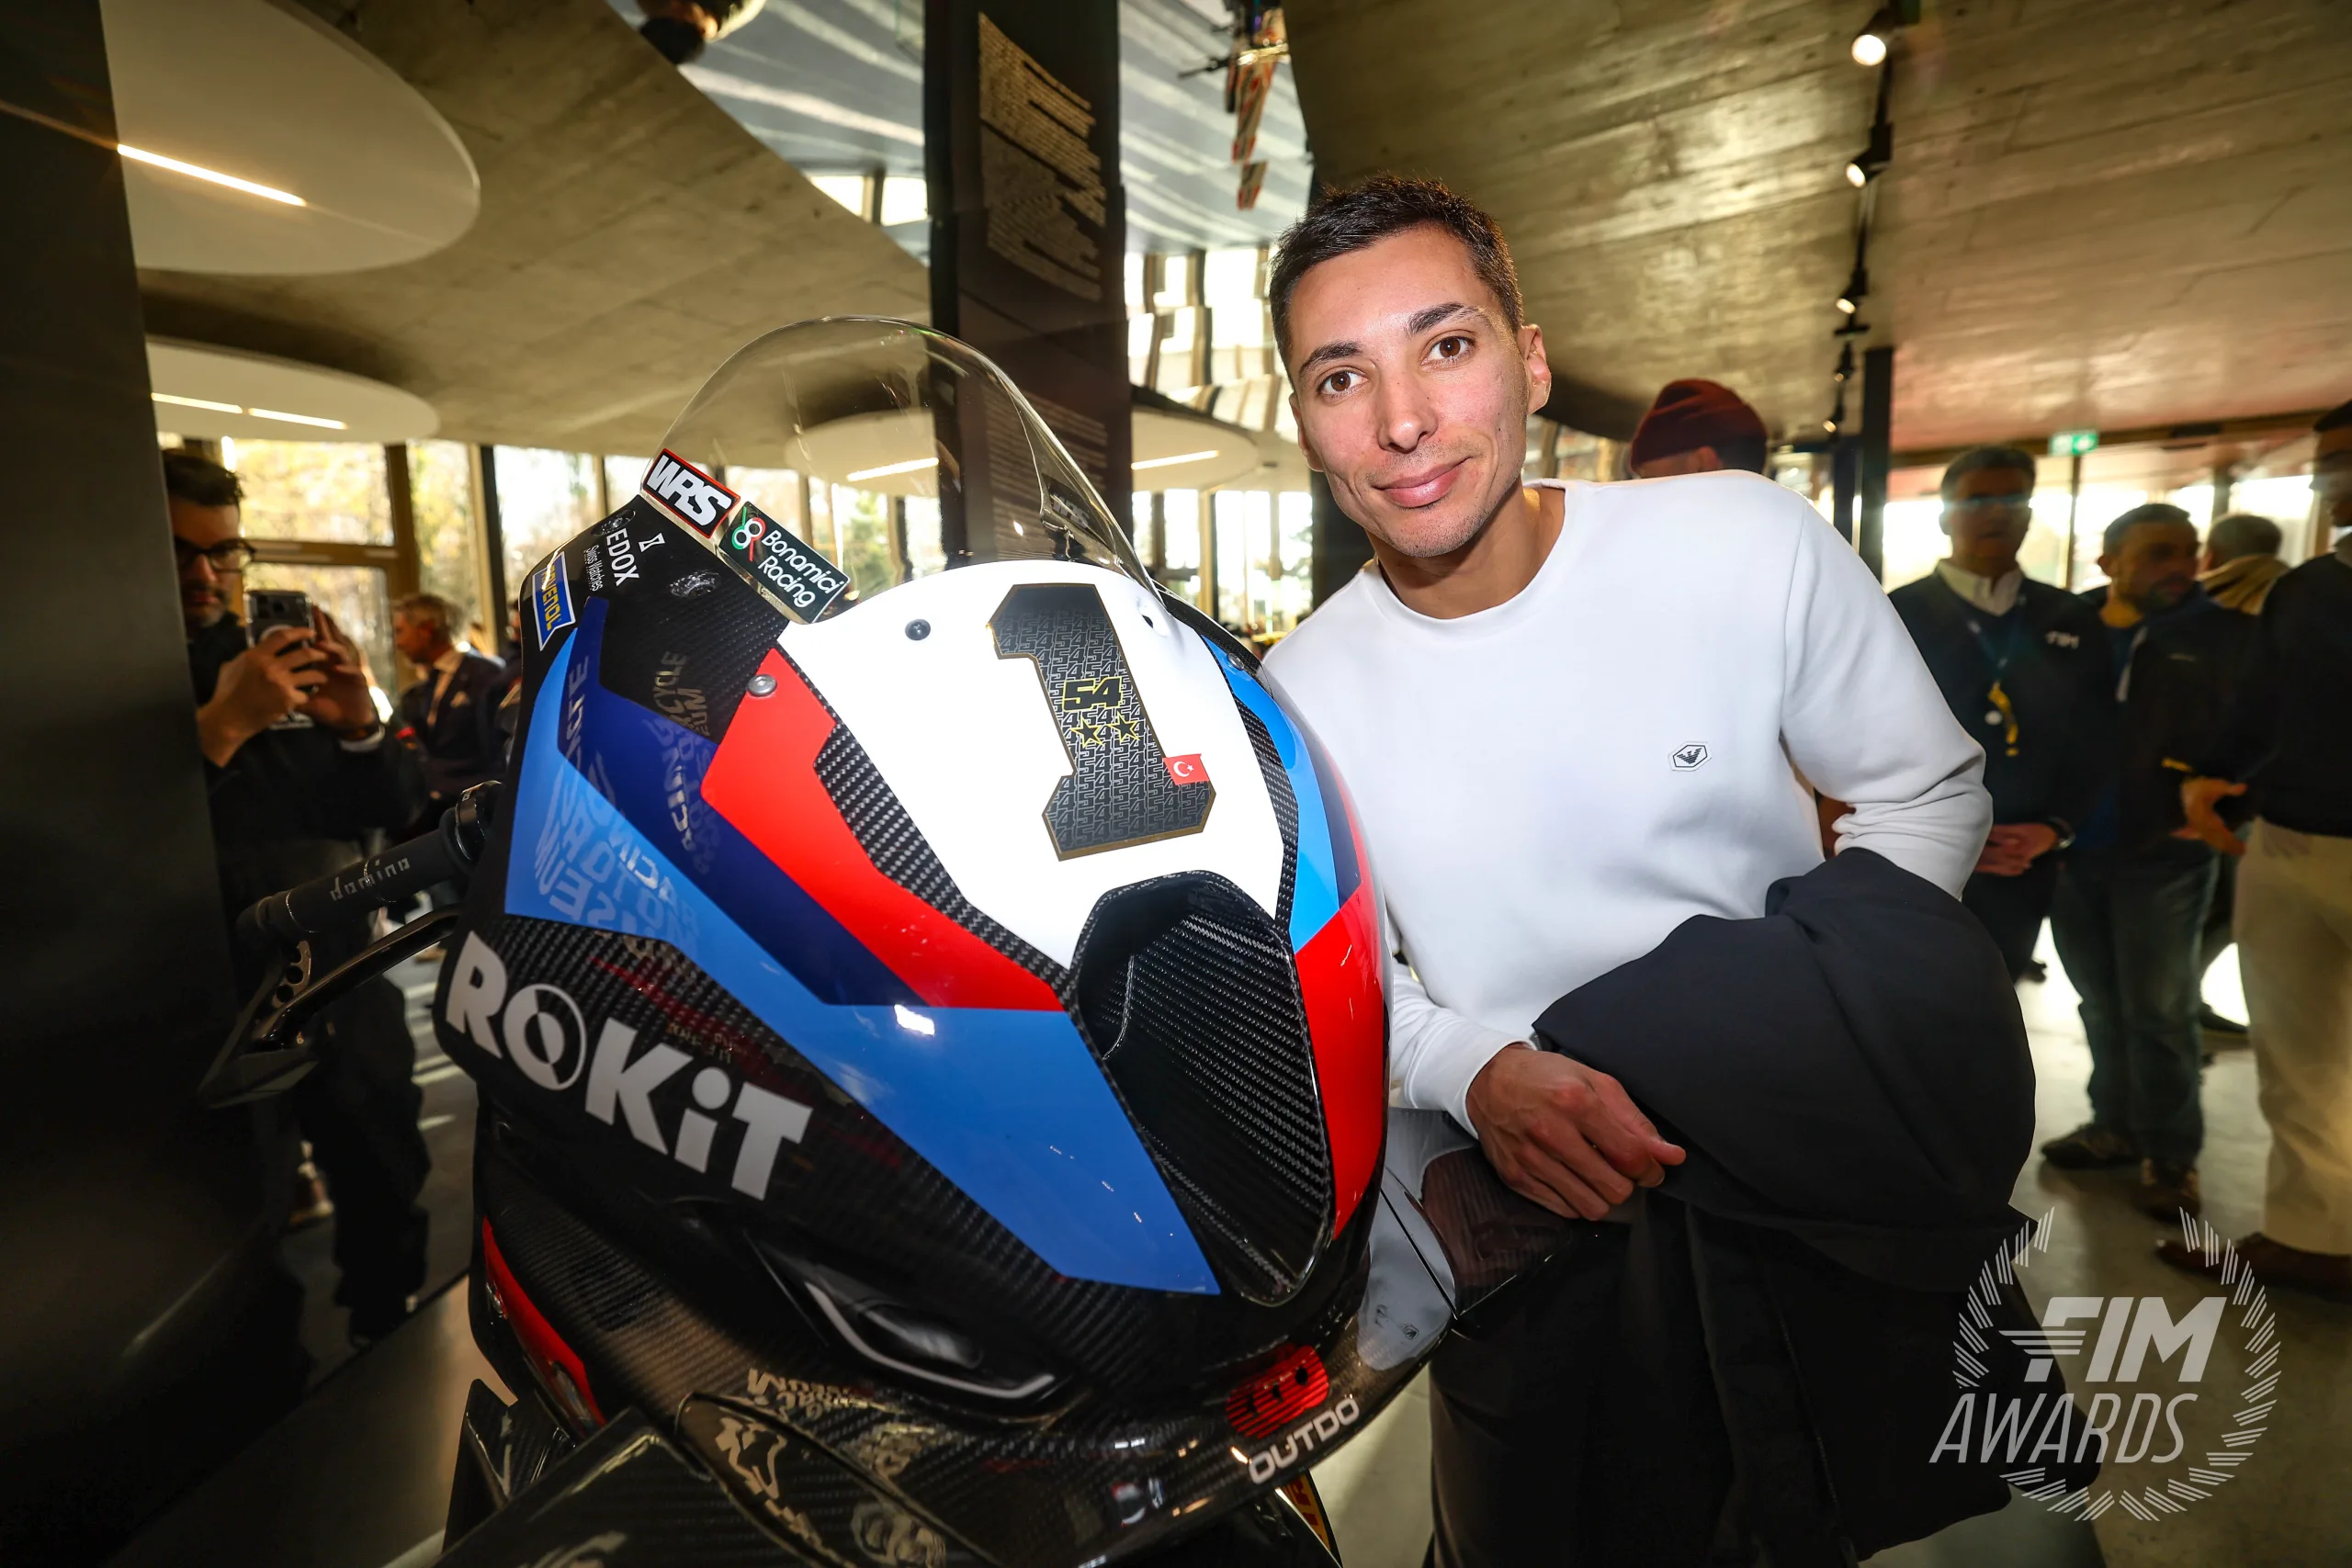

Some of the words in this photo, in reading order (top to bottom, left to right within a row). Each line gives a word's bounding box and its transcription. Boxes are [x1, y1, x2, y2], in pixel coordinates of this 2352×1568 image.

[646, 455, 732, 526] WRS
[606, 528, 639, 586] EDOX
[758, 555, 816, 607] Racing
[762, 530, 844, 593] Bonamici
[1062, 676, 1123, 712] 54
[329, 857, 411, 901] domino
[1249, 1397, 1360, 1484] OUTDO
